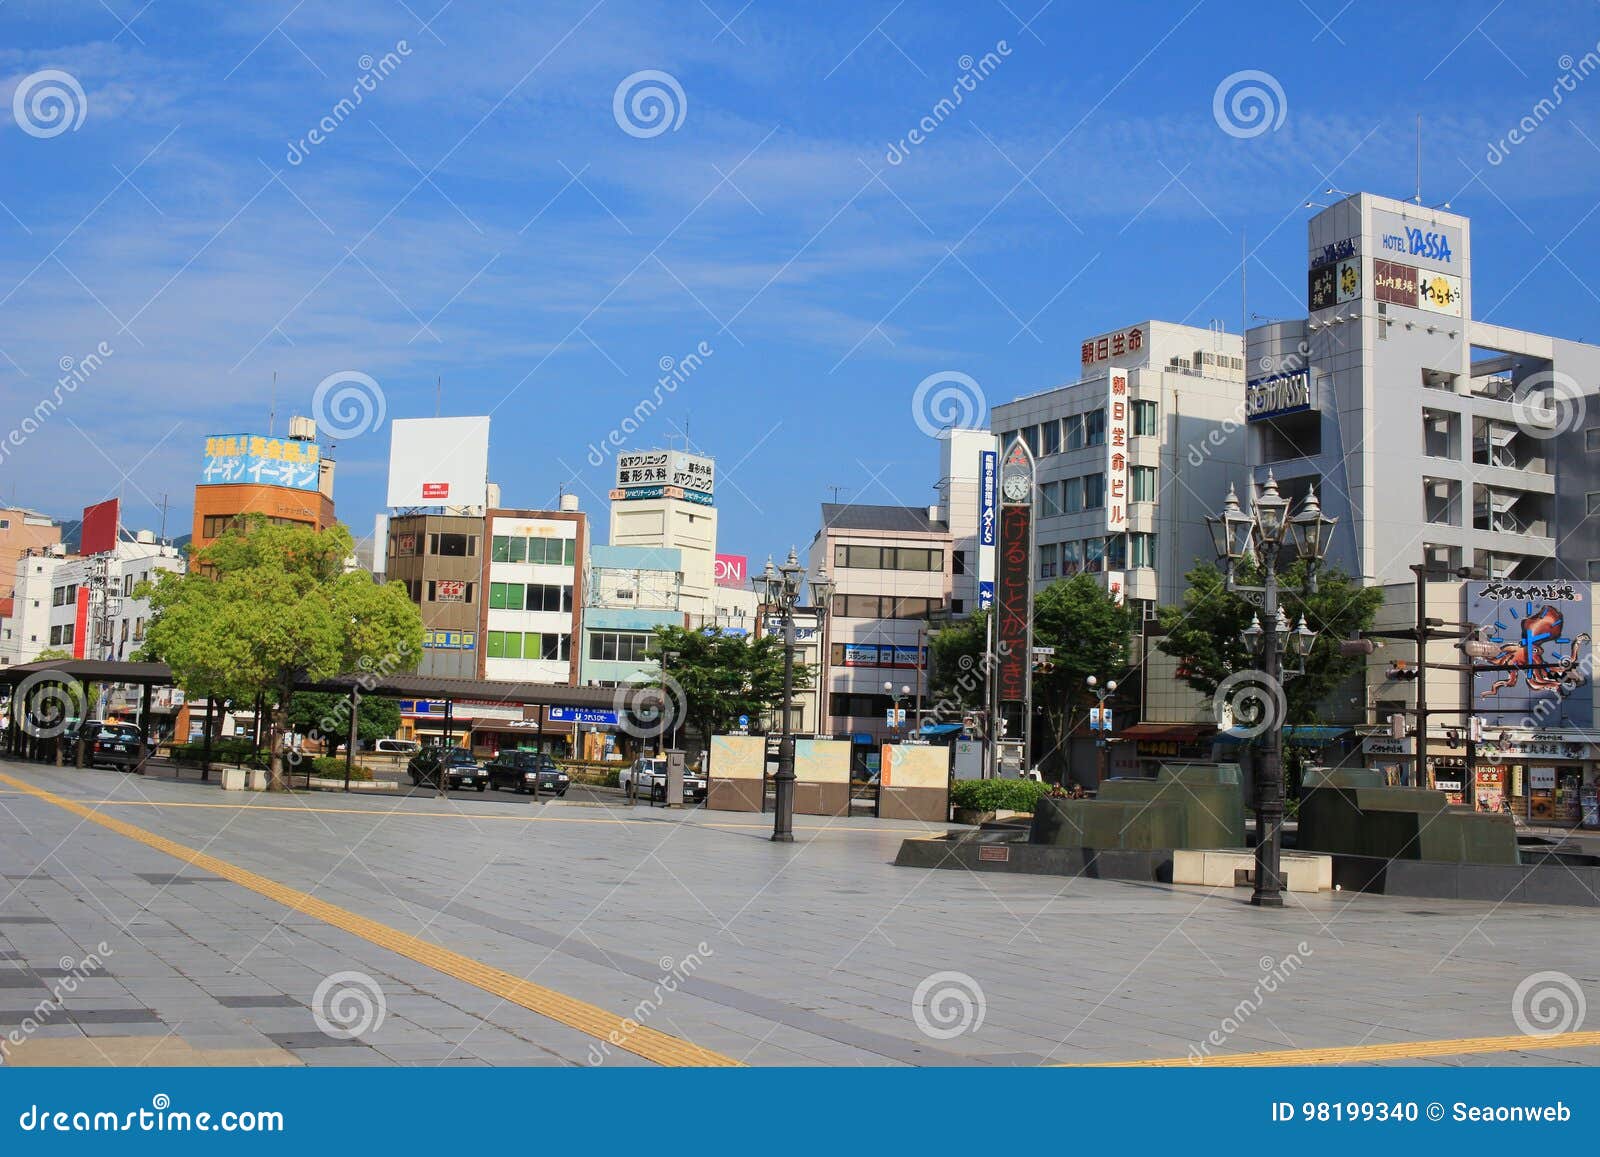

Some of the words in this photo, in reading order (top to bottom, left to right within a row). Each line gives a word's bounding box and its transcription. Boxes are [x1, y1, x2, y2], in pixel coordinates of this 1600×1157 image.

[1323, 238, 1356, 263] YASSA
[1382, 233, 1405, 252] HOTEL
[1405, 226, 1452, 262] YASSA
[1375, 274, 1413, 294] 山内農場
[1420, 278, 1461, 304] わらわら
[1081, 328, 1143, 364] 朝日生命
[620, 454, 668, 467] 松下クリニック
[1110, 375, 1126, 524] 朝日生命ビル
[203, 455, 247, 483] イーオン
[247, 459, 317, 486] イーオン
[619, 468, 667, 482] 整形外科
[688, 462, 712, 475] 整形外科
[673, 472, 713, 491] 松下クリニック
[1479, 583, 1575, 601] さかなや道場
